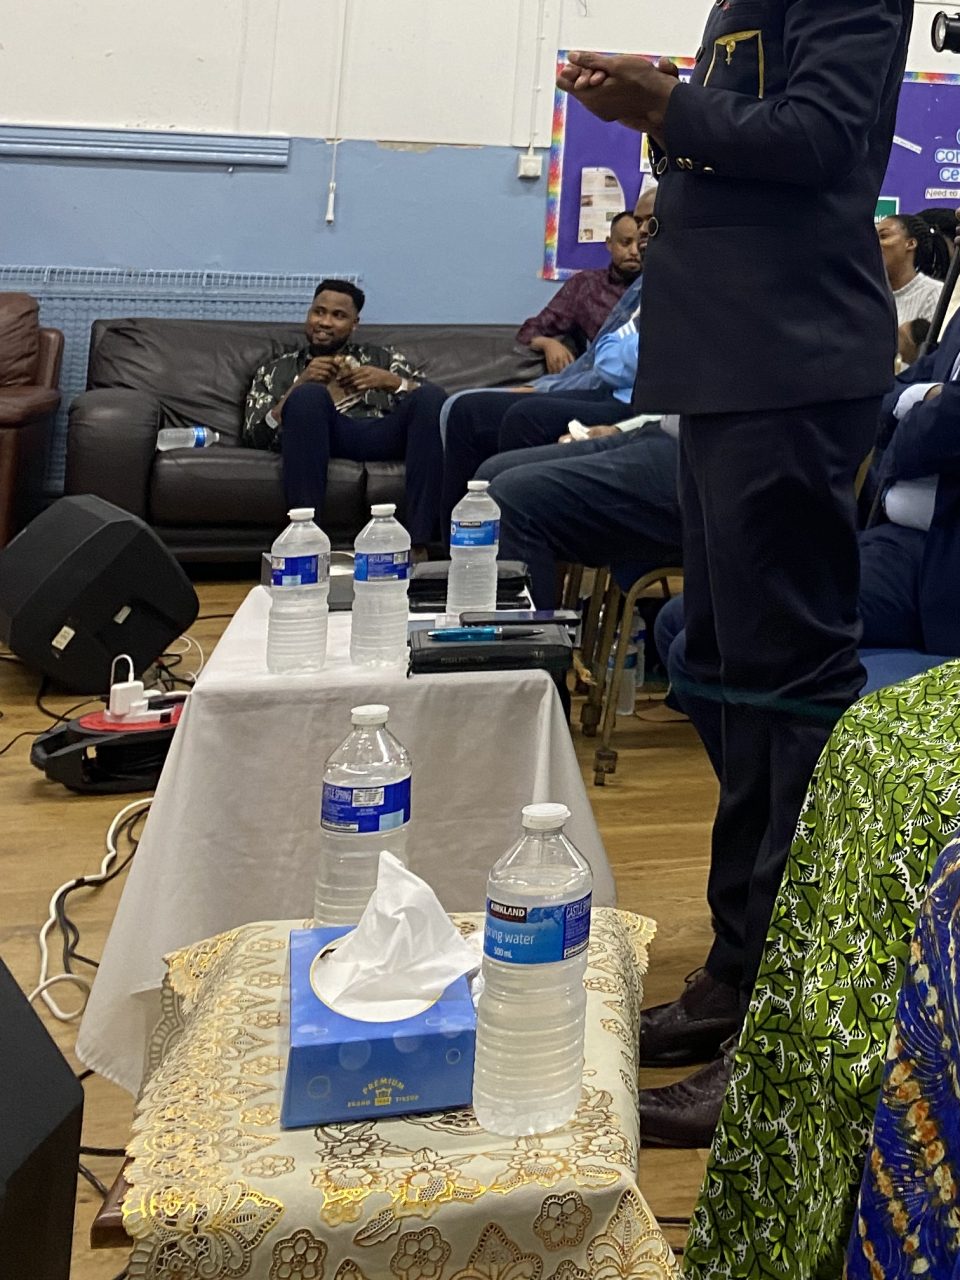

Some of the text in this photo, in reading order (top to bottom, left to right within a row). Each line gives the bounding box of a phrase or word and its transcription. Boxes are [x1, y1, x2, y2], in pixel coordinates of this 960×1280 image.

[926, 189, 947, 198] Need
[491, 903, 525, 917] KIRKLAND
[504, 933, 535, 945] water
[362, 1077, 405, 1095] PREMIUM
